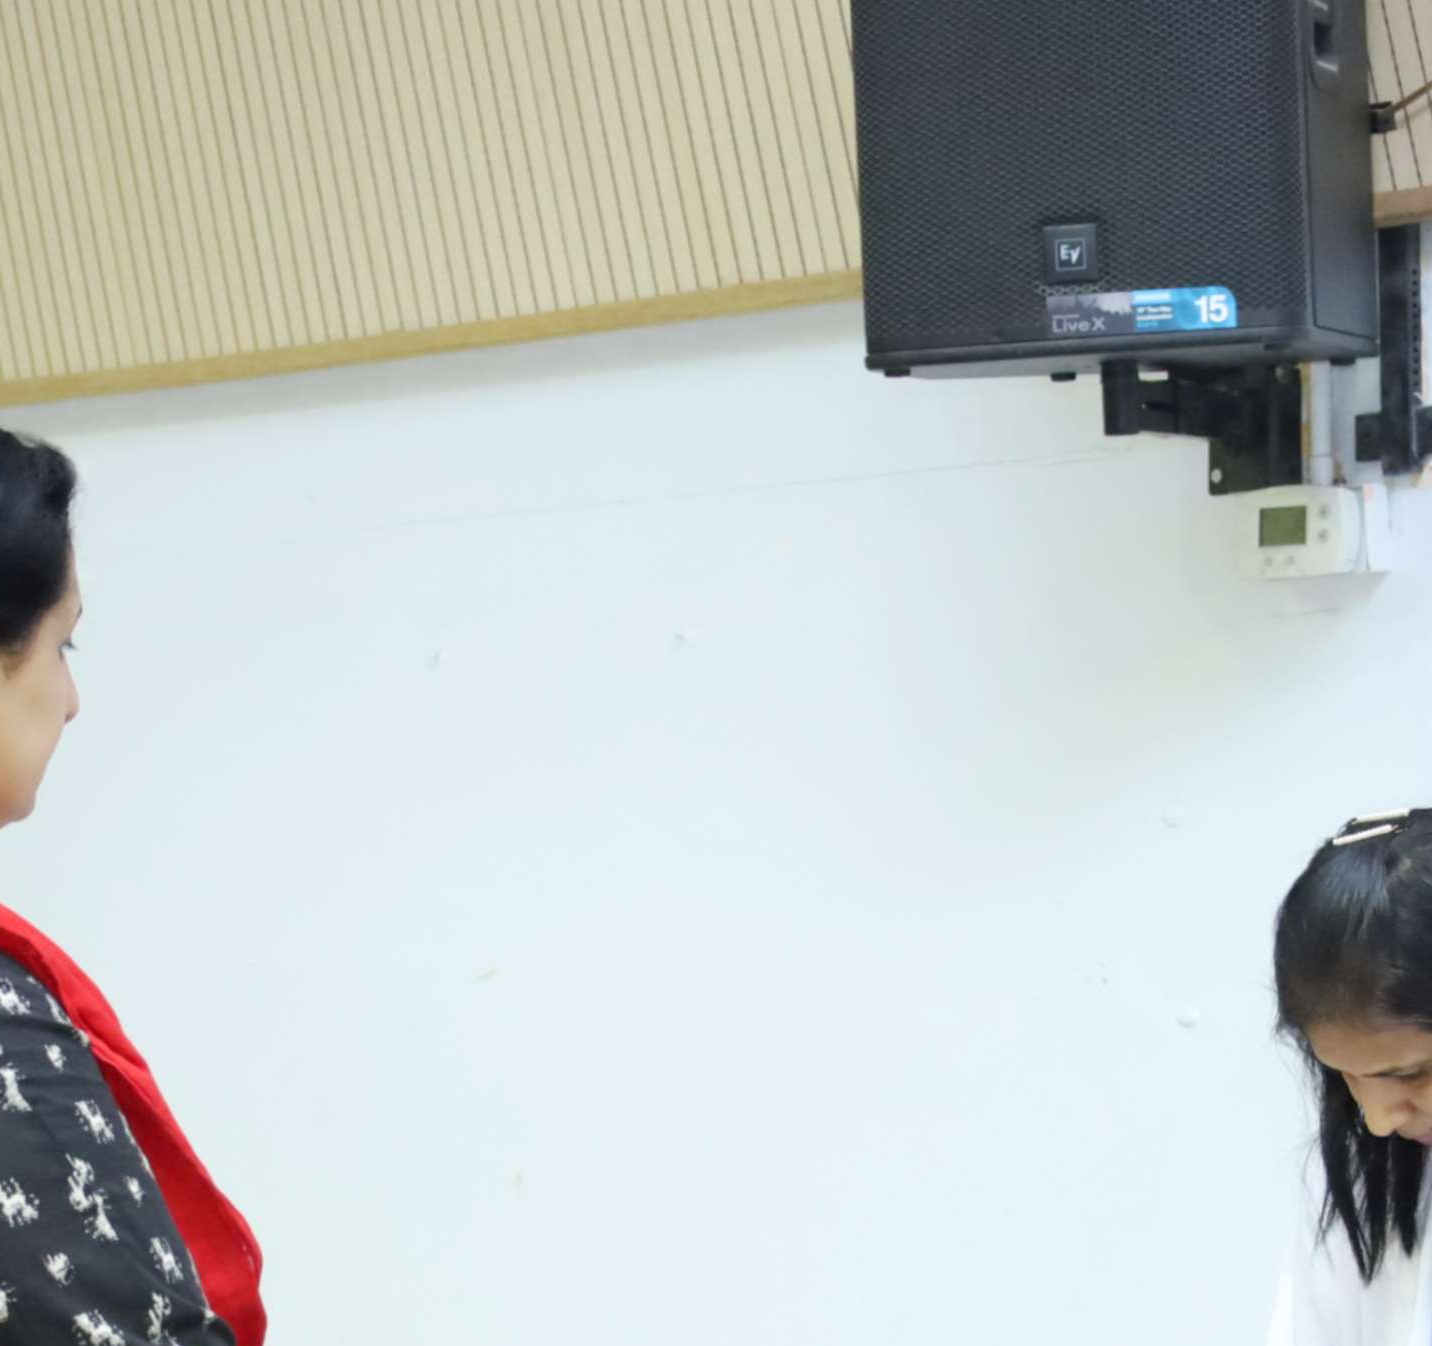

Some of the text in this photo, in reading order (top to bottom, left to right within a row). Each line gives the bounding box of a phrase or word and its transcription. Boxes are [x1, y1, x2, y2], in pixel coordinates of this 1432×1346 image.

[1193, 293, 1229, 324] 15
[1051, 315, 1106, 334] Live X
